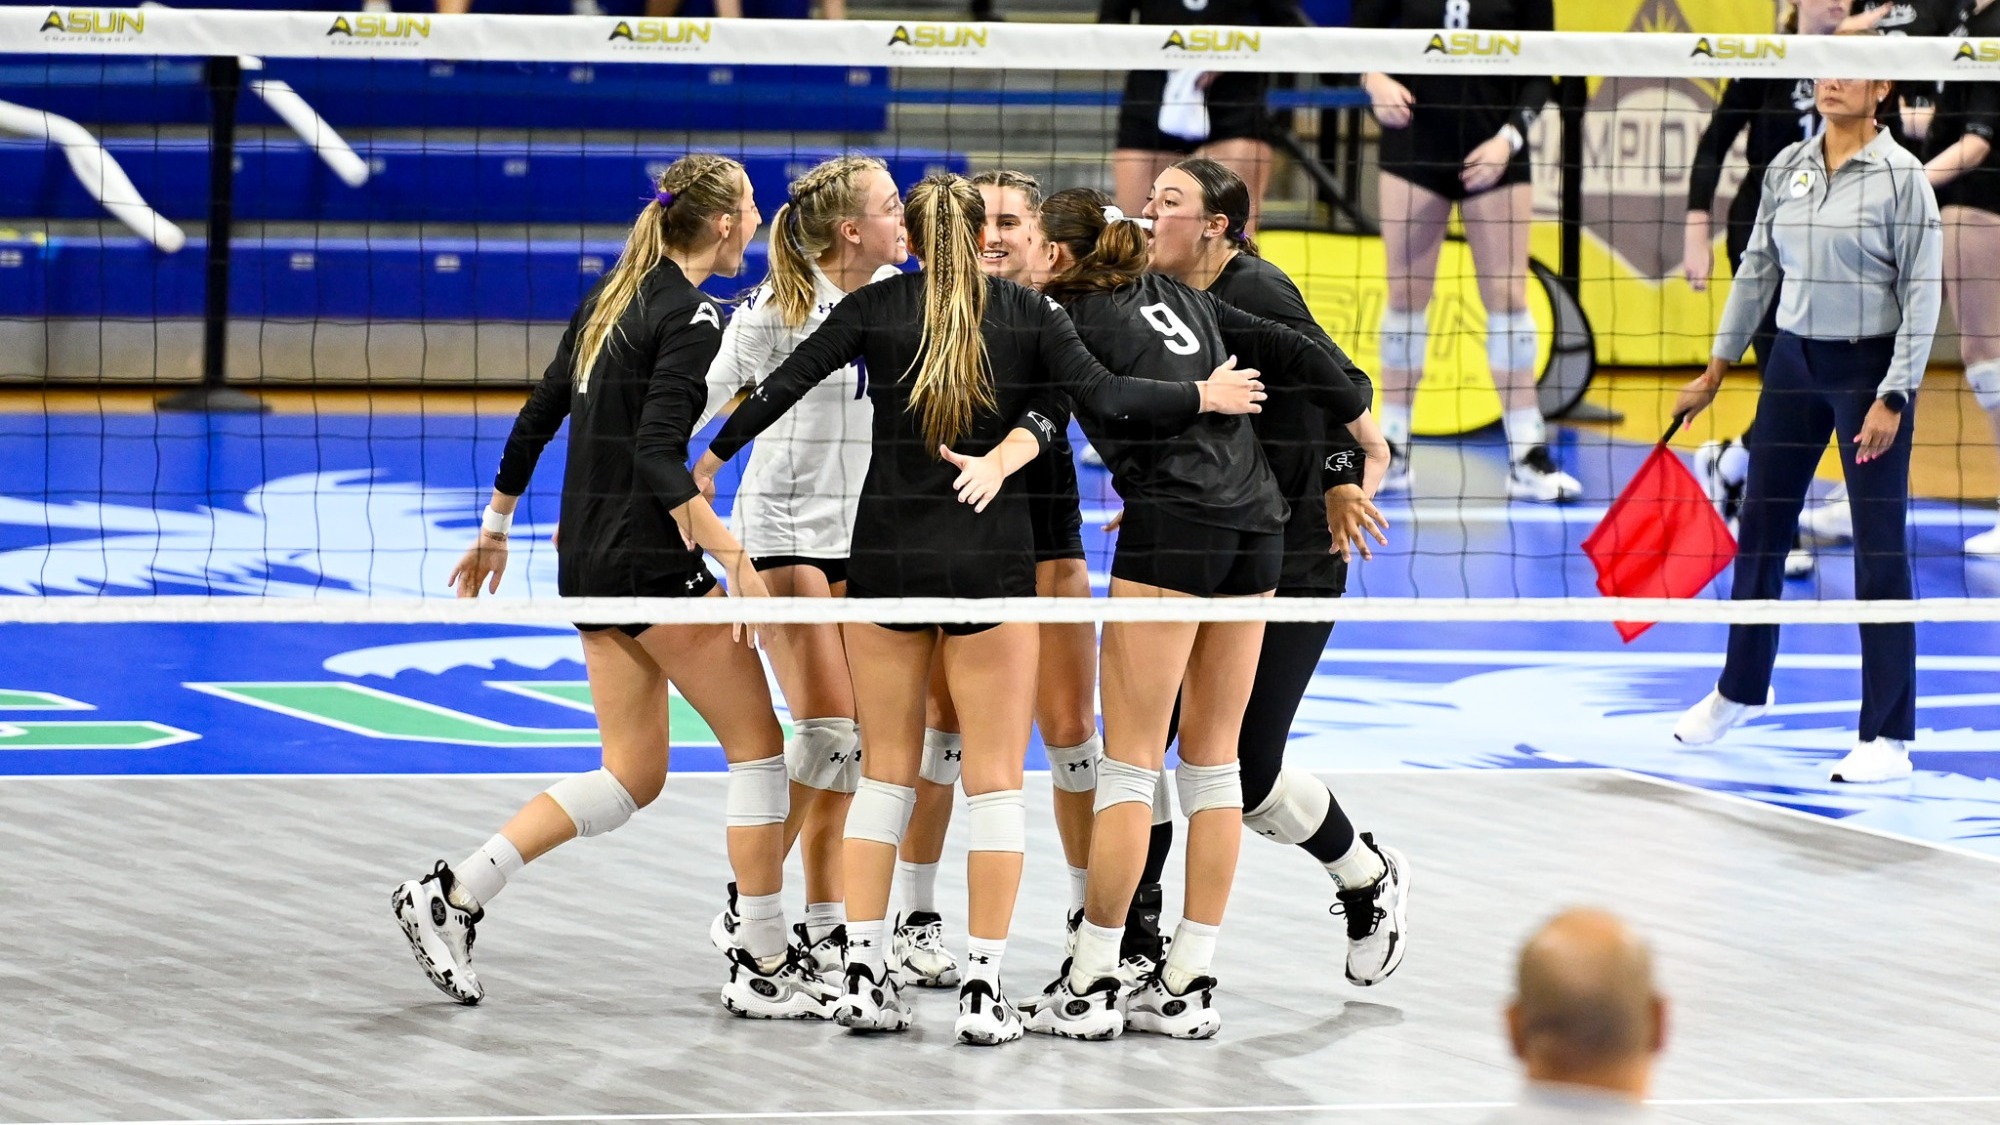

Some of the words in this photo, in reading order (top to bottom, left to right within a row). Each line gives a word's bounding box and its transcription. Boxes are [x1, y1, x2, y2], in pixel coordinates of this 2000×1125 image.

[40, 10, 145, 33] ASUN
[326, 15, 431, 38] ASUN
[608, 20, 712, 43] ASUN
[887, 25, 988, 48] ASUN
[1161, 29, 1261, 52] ASUN
[1424, 33, 1521, 56] ASUN
[1690, 37, 1787, 60] ASUN
[1953, 41, 2000, 62] AS
[1140, 302, 1200, 355] 9
